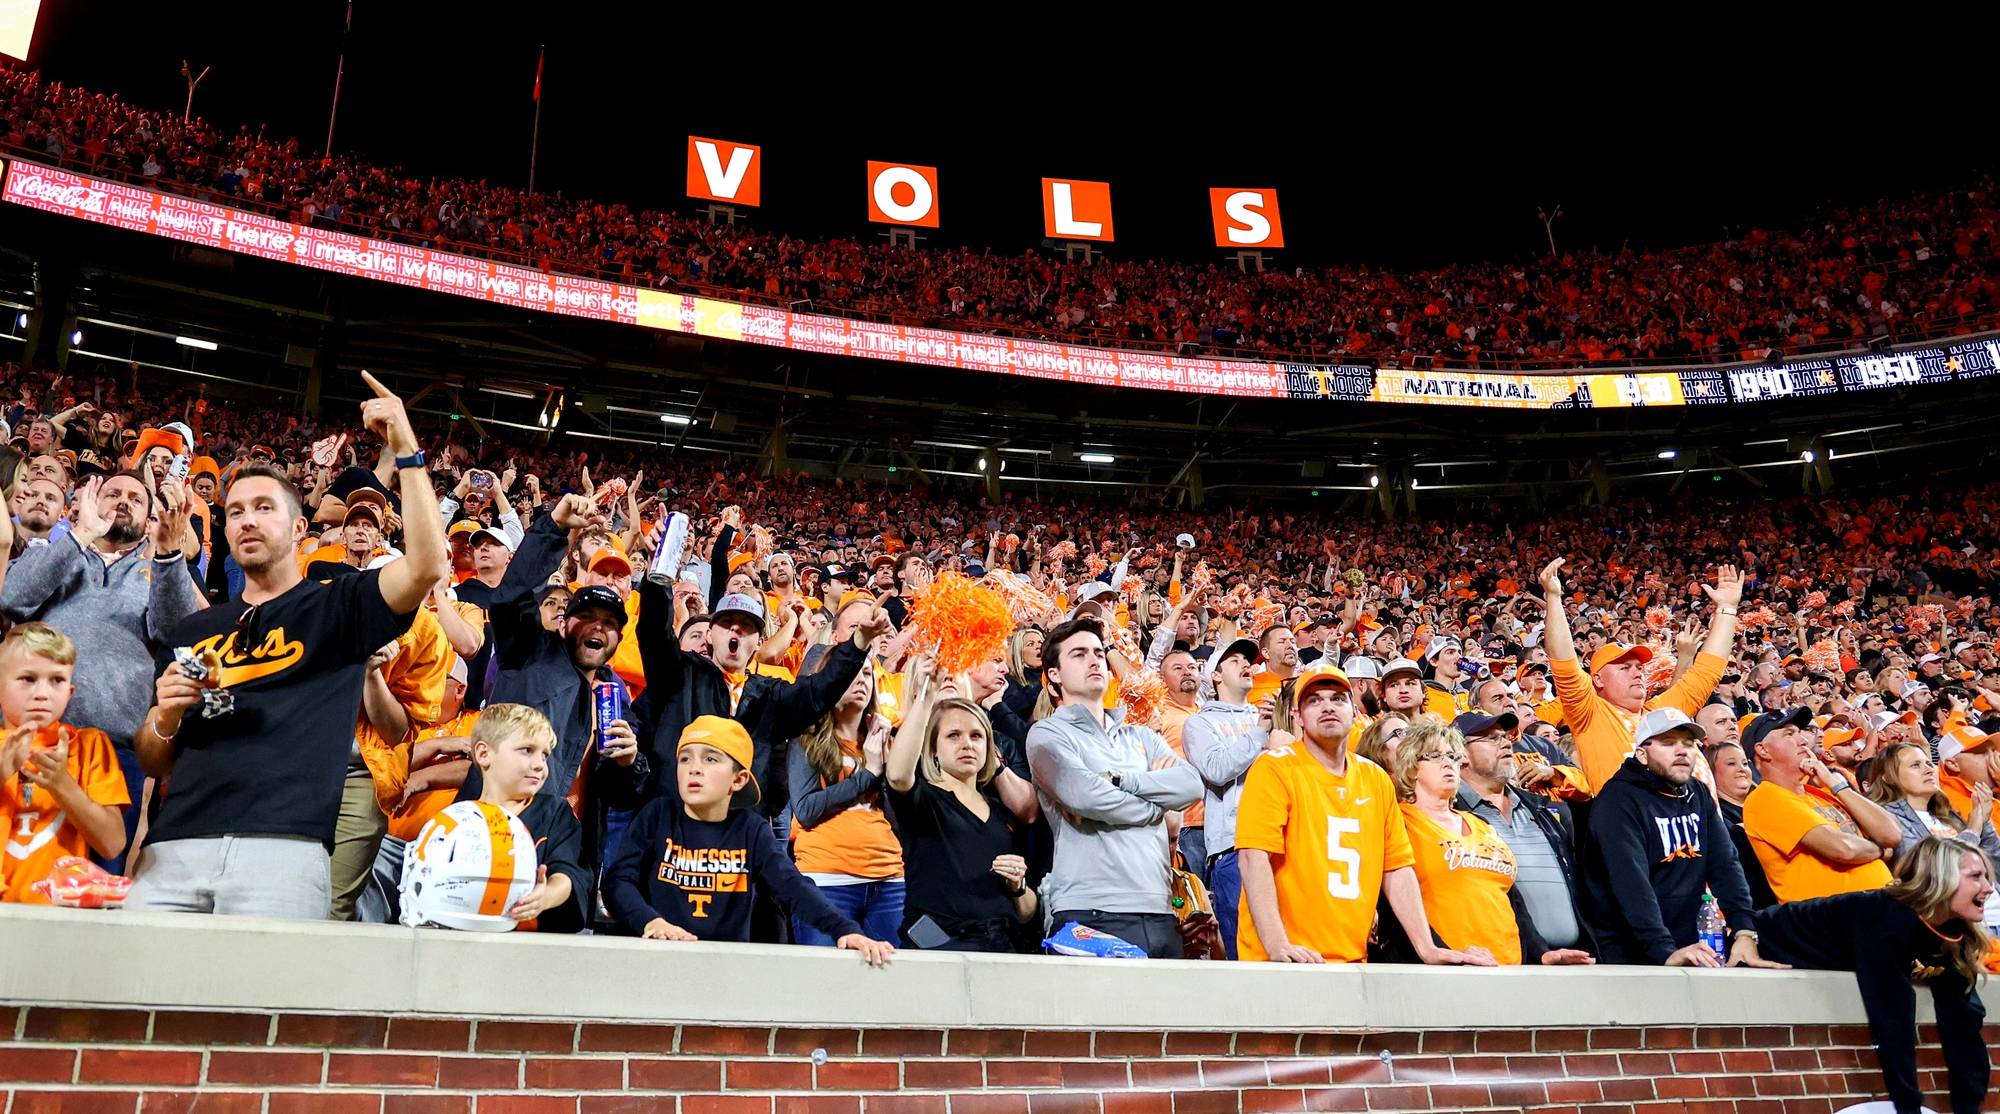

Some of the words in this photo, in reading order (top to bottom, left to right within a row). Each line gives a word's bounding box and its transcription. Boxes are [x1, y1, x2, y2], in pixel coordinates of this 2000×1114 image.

[696, 142, 754, 199] V
[874, 167, 933, 222] O
[1053, 182, 1102, 237] L
[1226, 191, 1271, 244] S
[210, 217, 308, 254] There's
[316, 244, 396, 274] magic
[402, 258, 474, 287] when
[481, 275, 521, 297] we
[524, 282, 600, 308] cheer
[602, 293, 705, 324] together
[864, 331, 947, 357] There's
[954, 342, 1017, 366] magic
[1023, 351, 1082, 375] when
[1087, 358, 1118, 377] we
[1125, 363, 1185, 384] cheer
[1188, 367, 1279, 389] together
[1326, 375, 1371, 396] NOISE
[1729, 367, 1793, 400] 1940
[1856, 354, 1921, 386] 1950
[1327, 816, 1361, 900] 5
